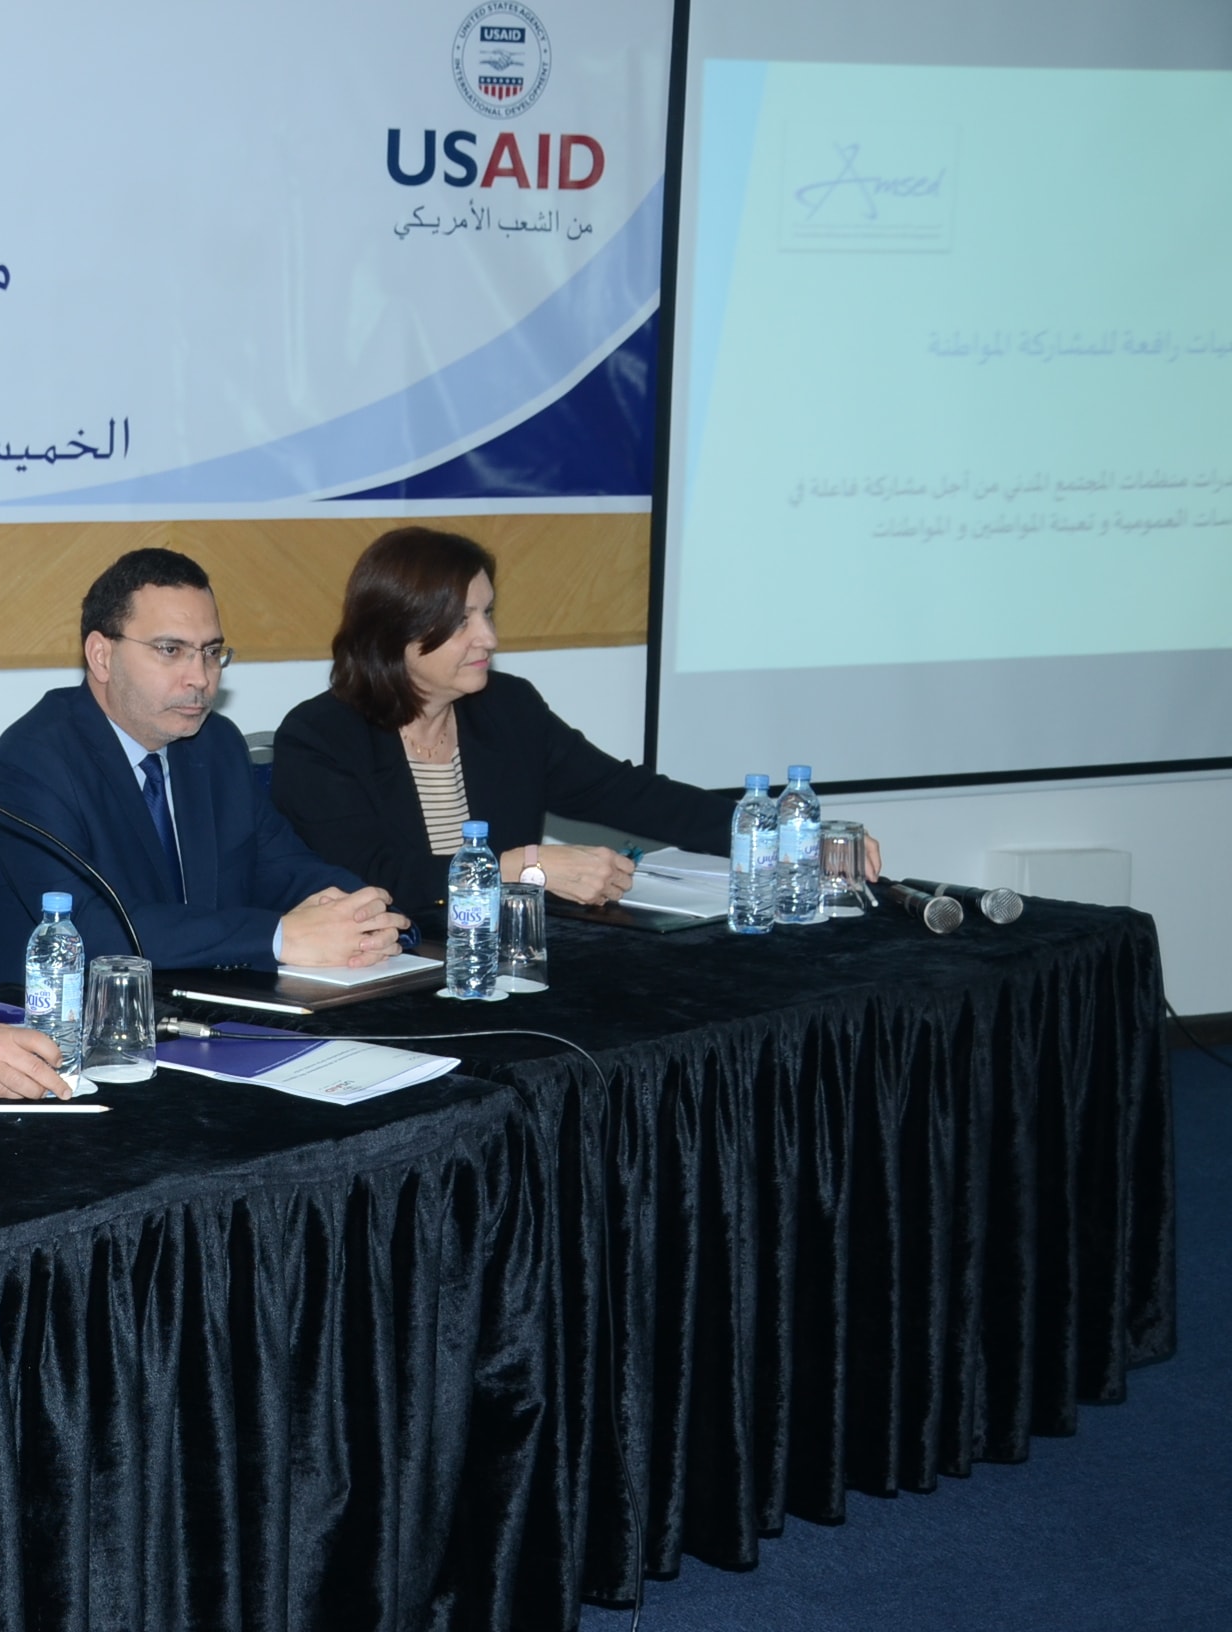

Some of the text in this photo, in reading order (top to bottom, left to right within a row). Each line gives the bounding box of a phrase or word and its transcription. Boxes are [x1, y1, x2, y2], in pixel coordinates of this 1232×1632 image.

[459, 2, 546, 41] UNITED STATES AGENCY
[483, 28, 522, 41] USAID
[454, 58, 549, 117] INTERNATIONAL DEVELOPMENT
[387, 128, 605, 190] USAID
[394, 199, 593, 241] من الشعب الأمريكي
[452, 904, 482, 922] Saïss
